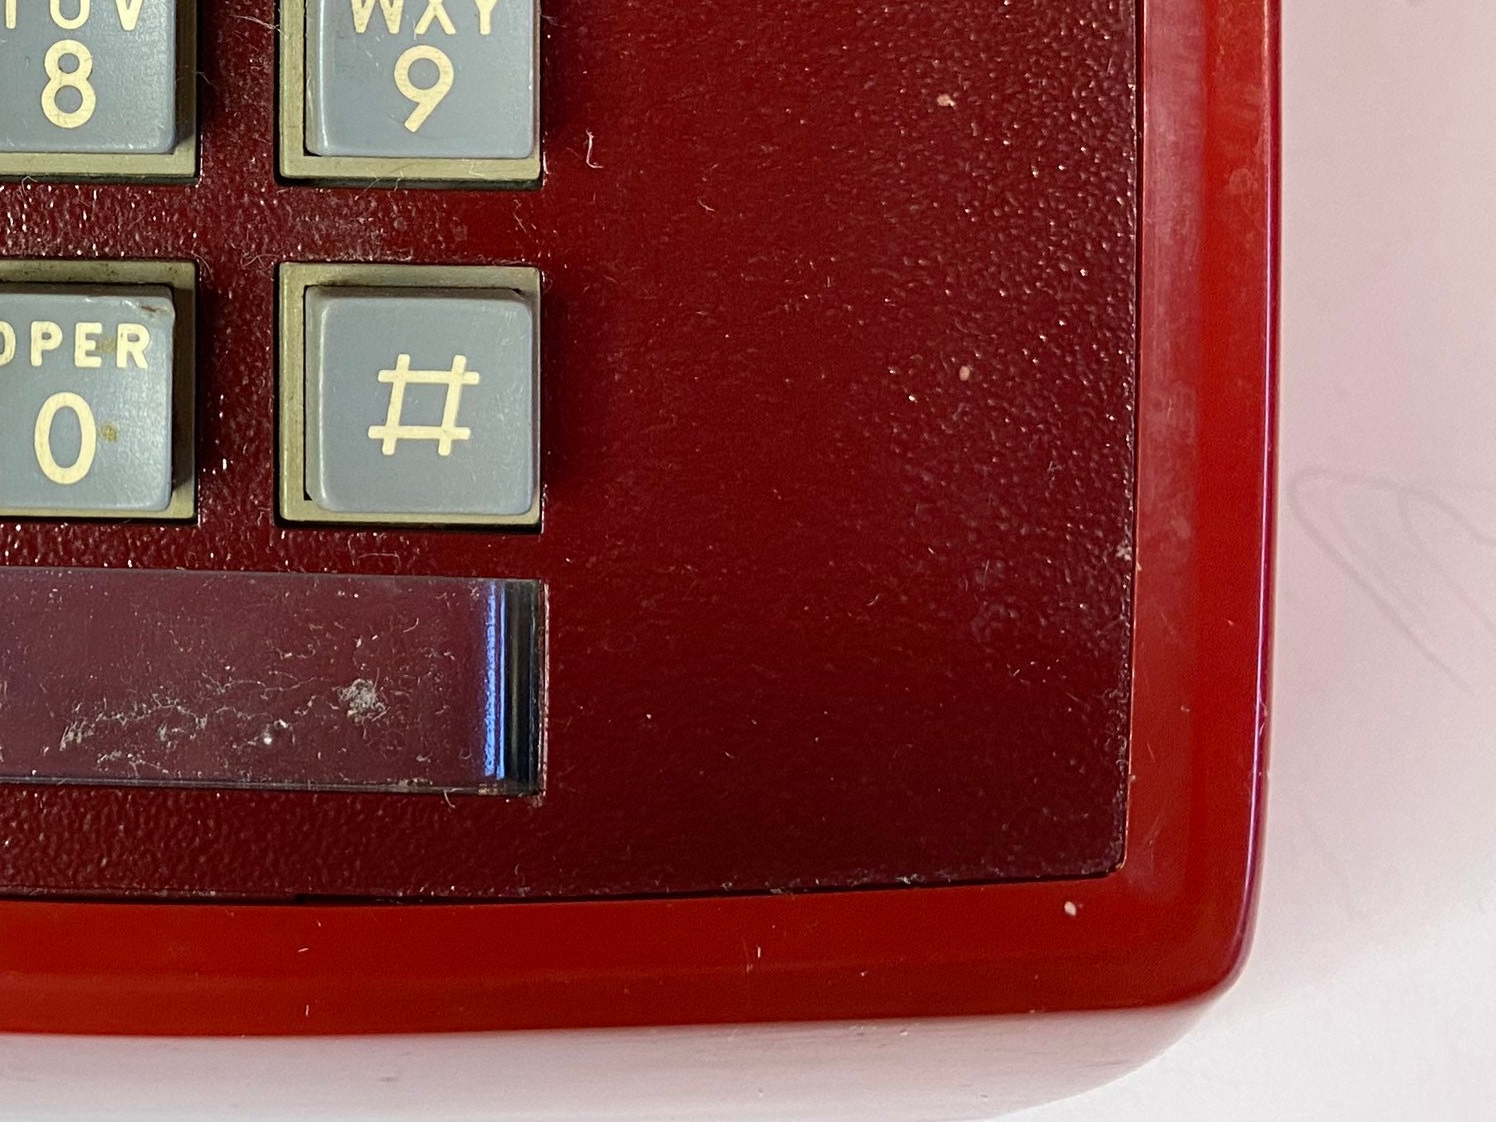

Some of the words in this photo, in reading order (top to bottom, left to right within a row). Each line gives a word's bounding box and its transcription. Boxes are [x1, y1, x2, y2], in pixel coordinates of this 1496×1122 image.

[41, 39, 96, 128] 8
[394, 45, 454, 132] 9
[35, 392, 97, 484] 0
[368, 354, 480, 457] #
